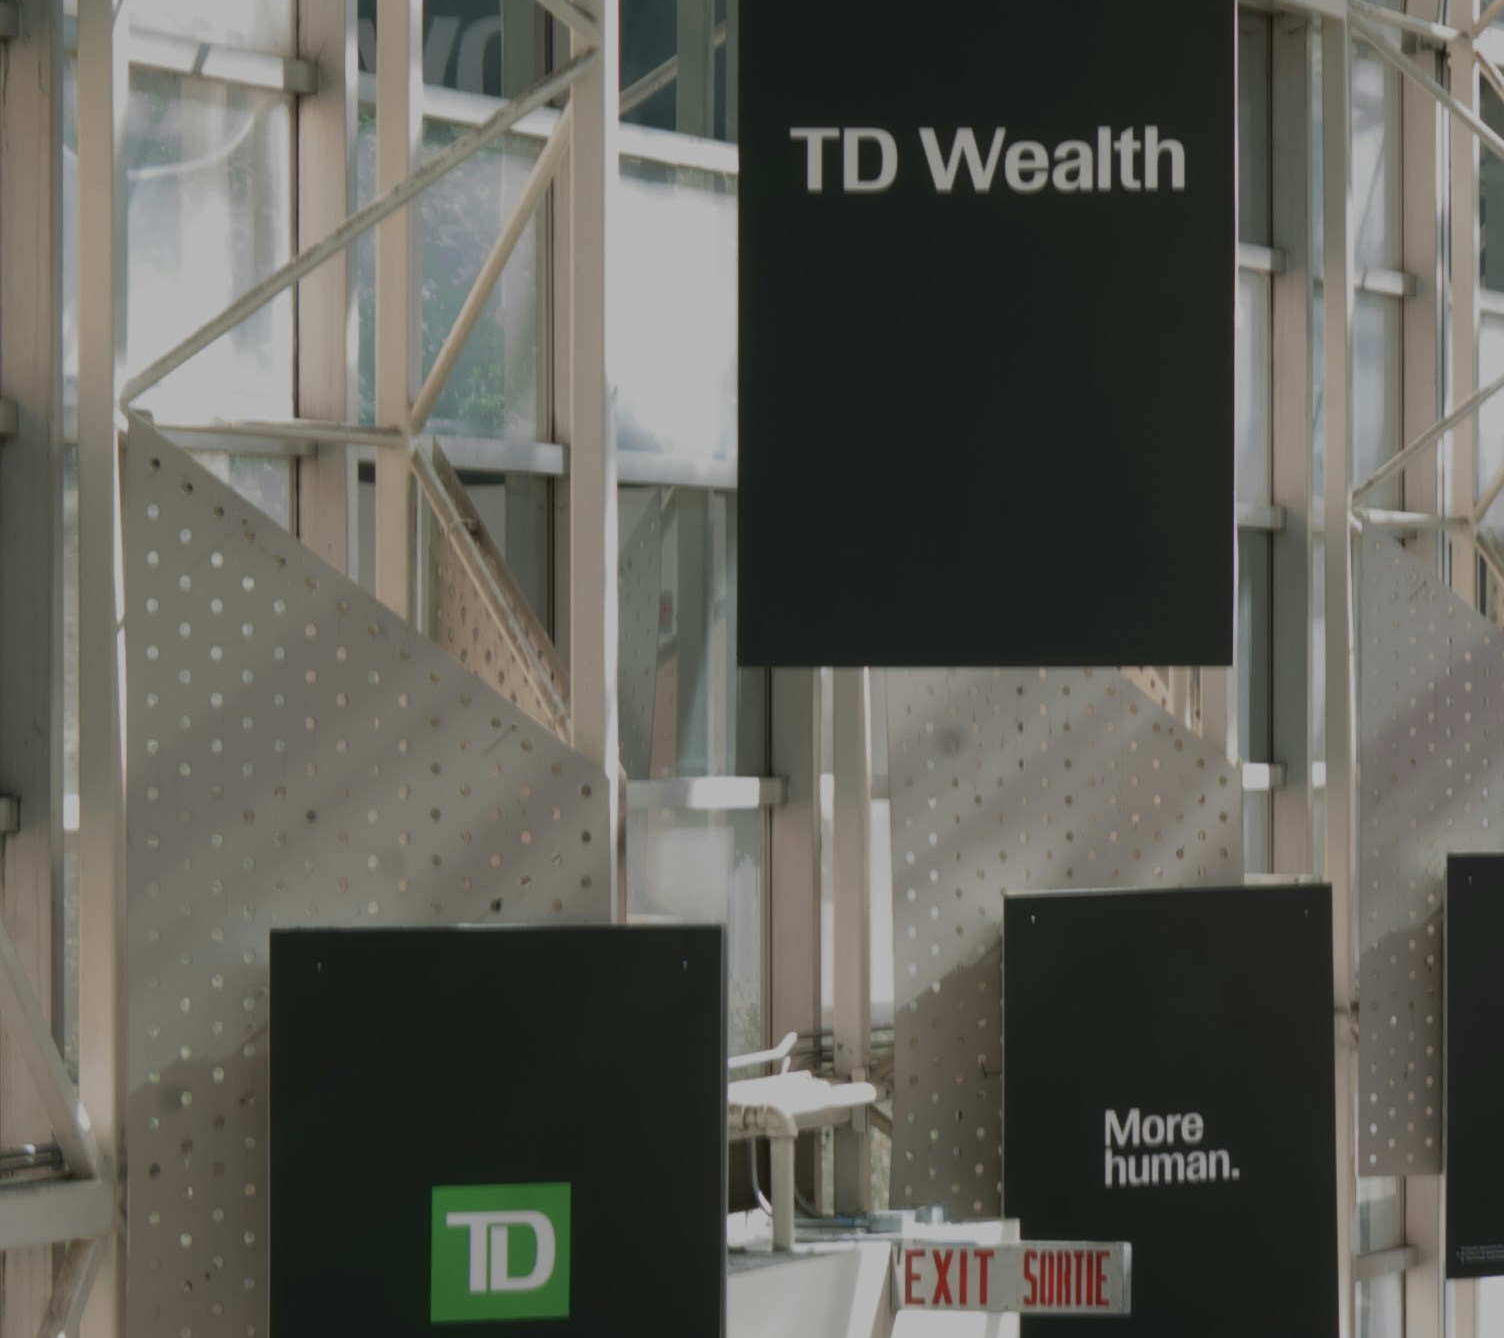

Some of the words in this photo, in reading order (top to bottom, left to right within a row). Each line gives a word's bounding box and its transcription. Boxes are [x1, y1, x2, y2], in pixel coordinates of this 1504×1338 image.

[790, 127, 898, 193] TD
[919, 125, 1186, 193] Wealth
[1104, 1107, 1204, 1147] More
[1104, 1147, 1240, 1188] human.
[446, 1210, 556, 1293] TD
[904, 1250, 994, 1305] EXIT
[1023, 1250, 1108, 1307] SORTIE
